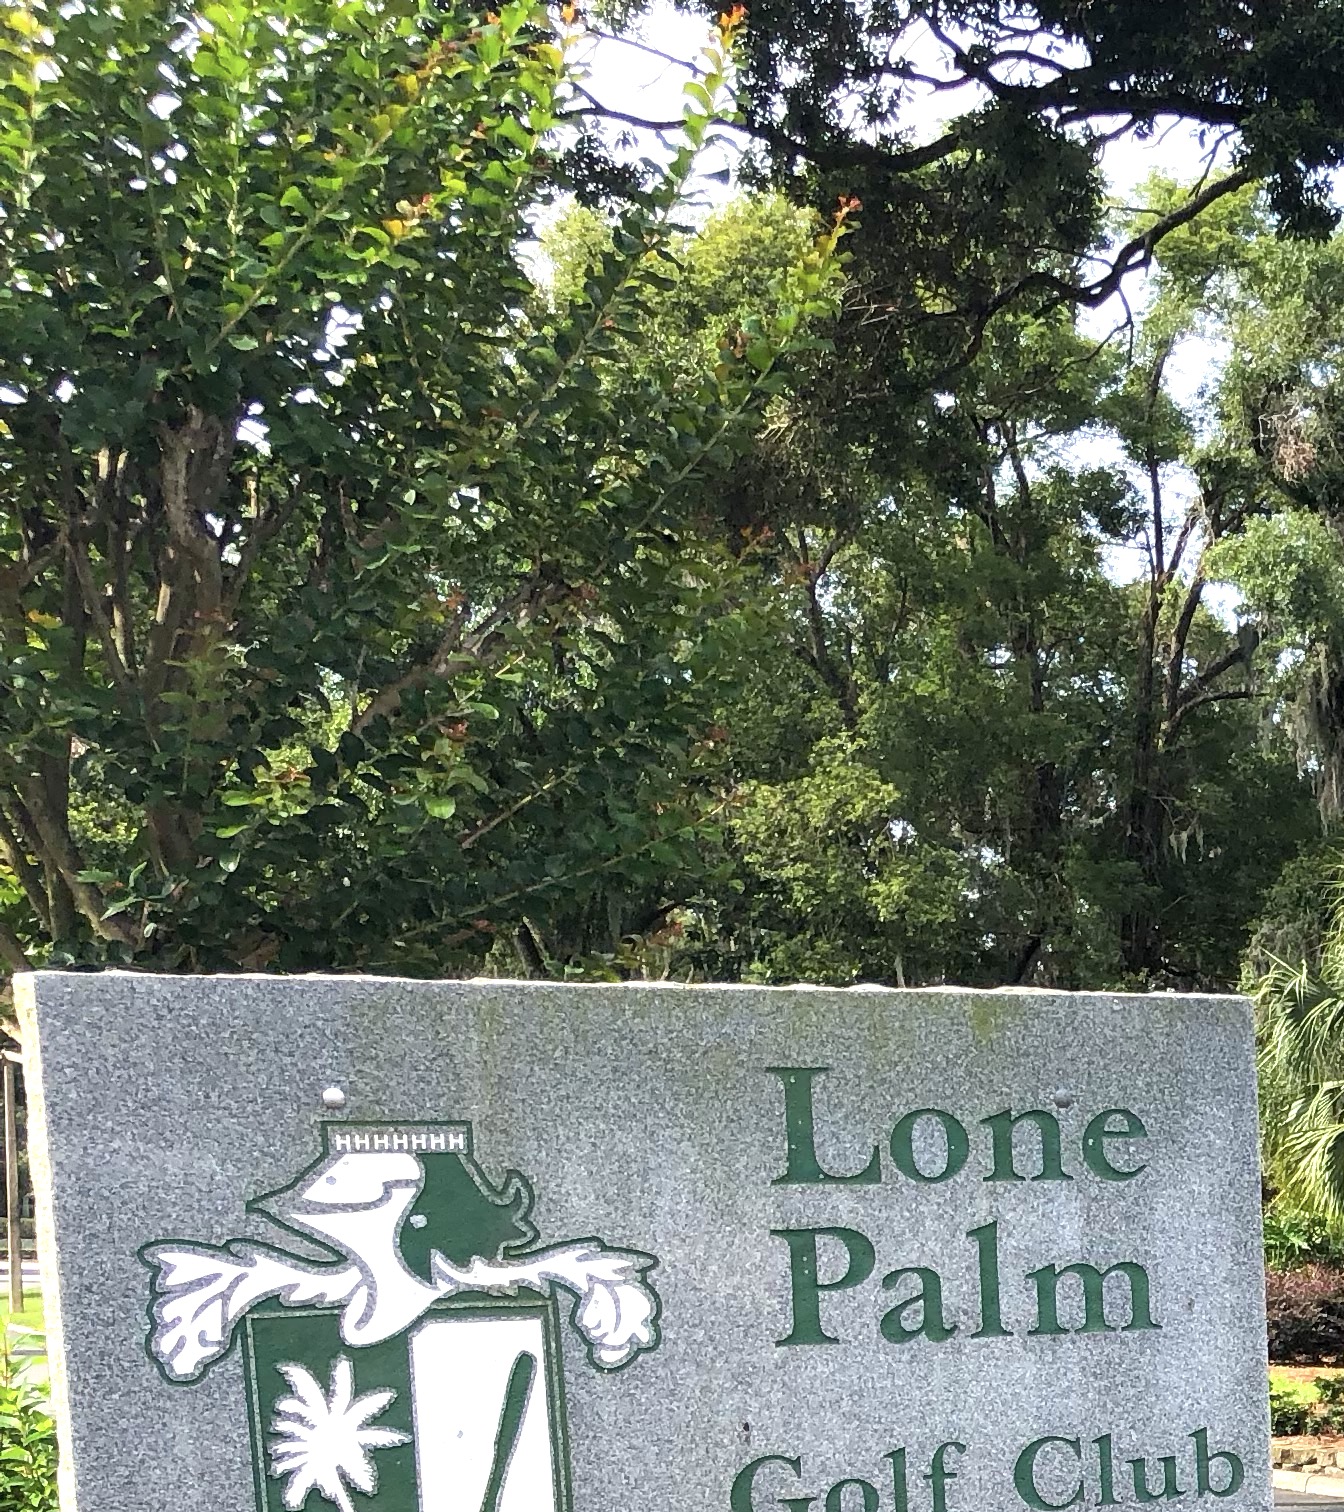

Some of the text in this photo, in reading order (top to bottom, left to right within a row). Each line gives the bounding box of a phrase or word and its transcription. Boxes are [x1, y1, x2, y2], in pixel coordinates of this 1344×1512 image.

[765, 1066, 1148, 1185] Lone
[769, 1220, 1163, 1348] Palm
[1013, 1426, 1245, 1512] Club
